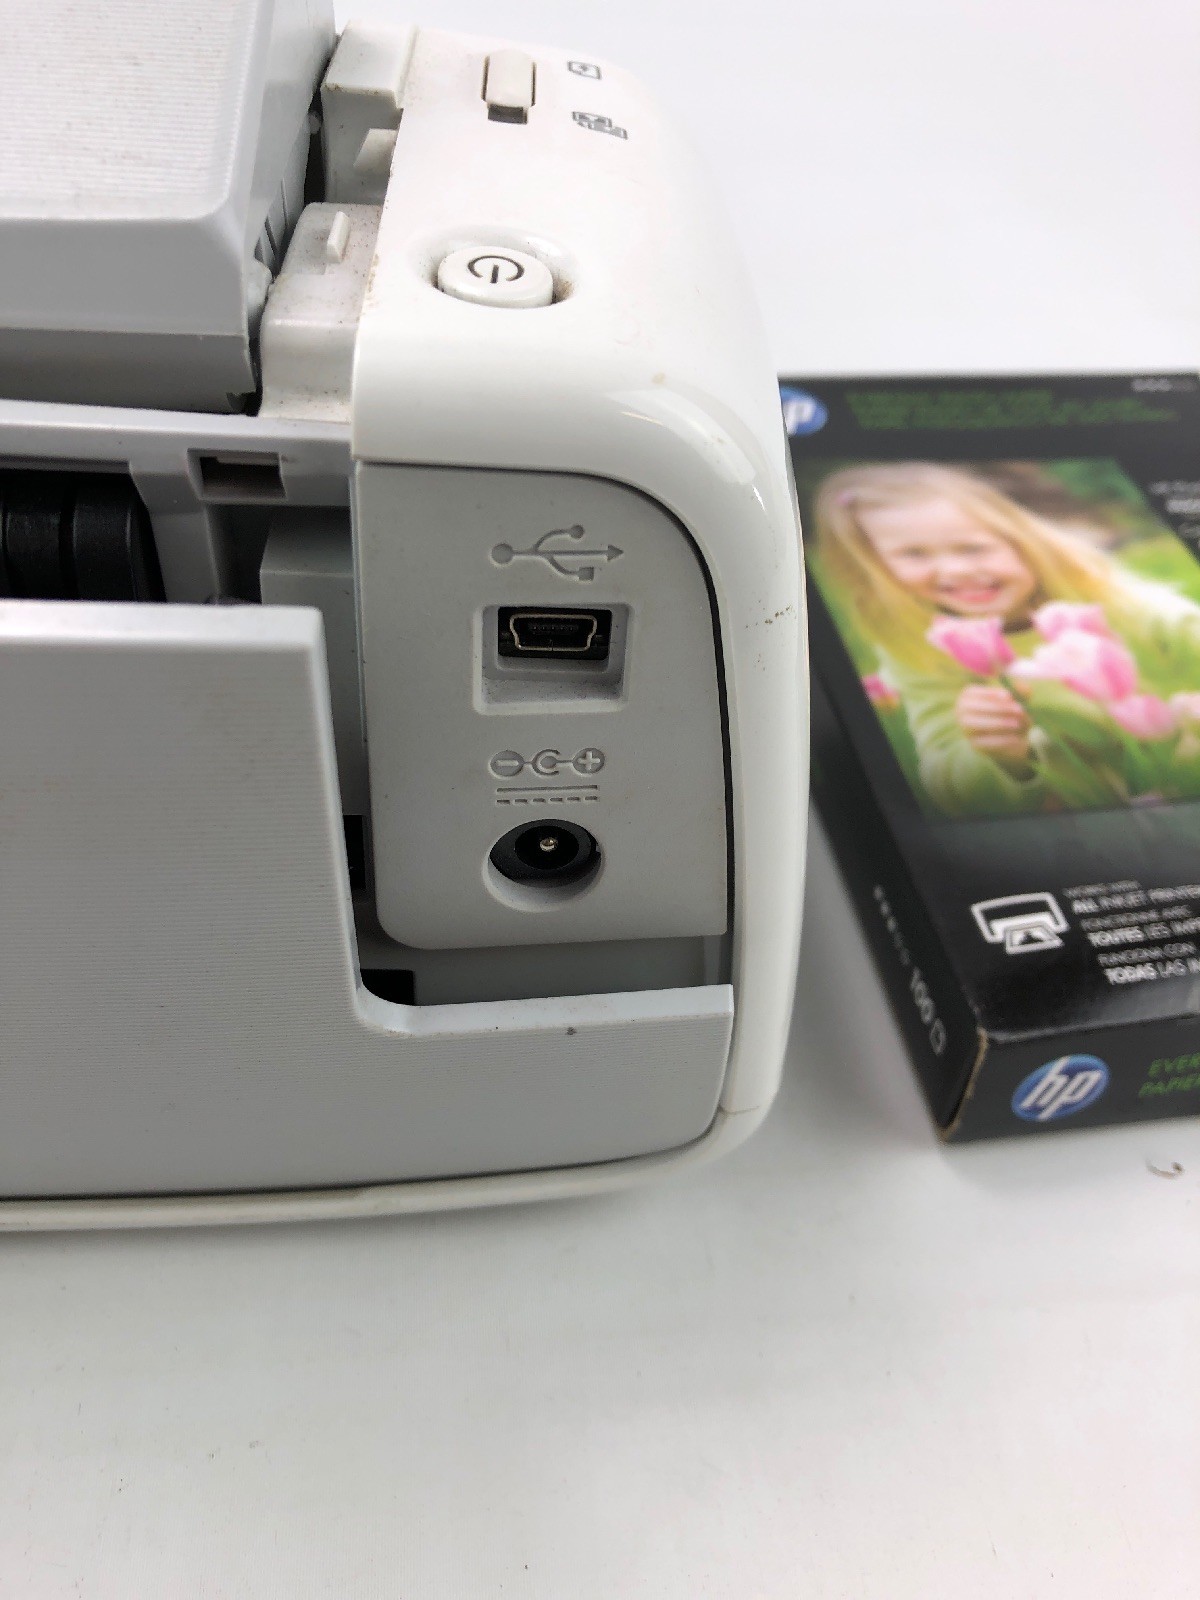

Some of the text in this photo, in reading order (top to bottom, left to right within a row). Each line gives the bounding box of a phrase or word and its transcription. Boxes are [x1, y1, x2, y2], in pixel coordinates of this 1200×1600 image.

[1104, 963, 1158, 985] TODAS
[1156, 959, 1187, 978] LAS
[1018, 1055, 1103, 1122] hp
